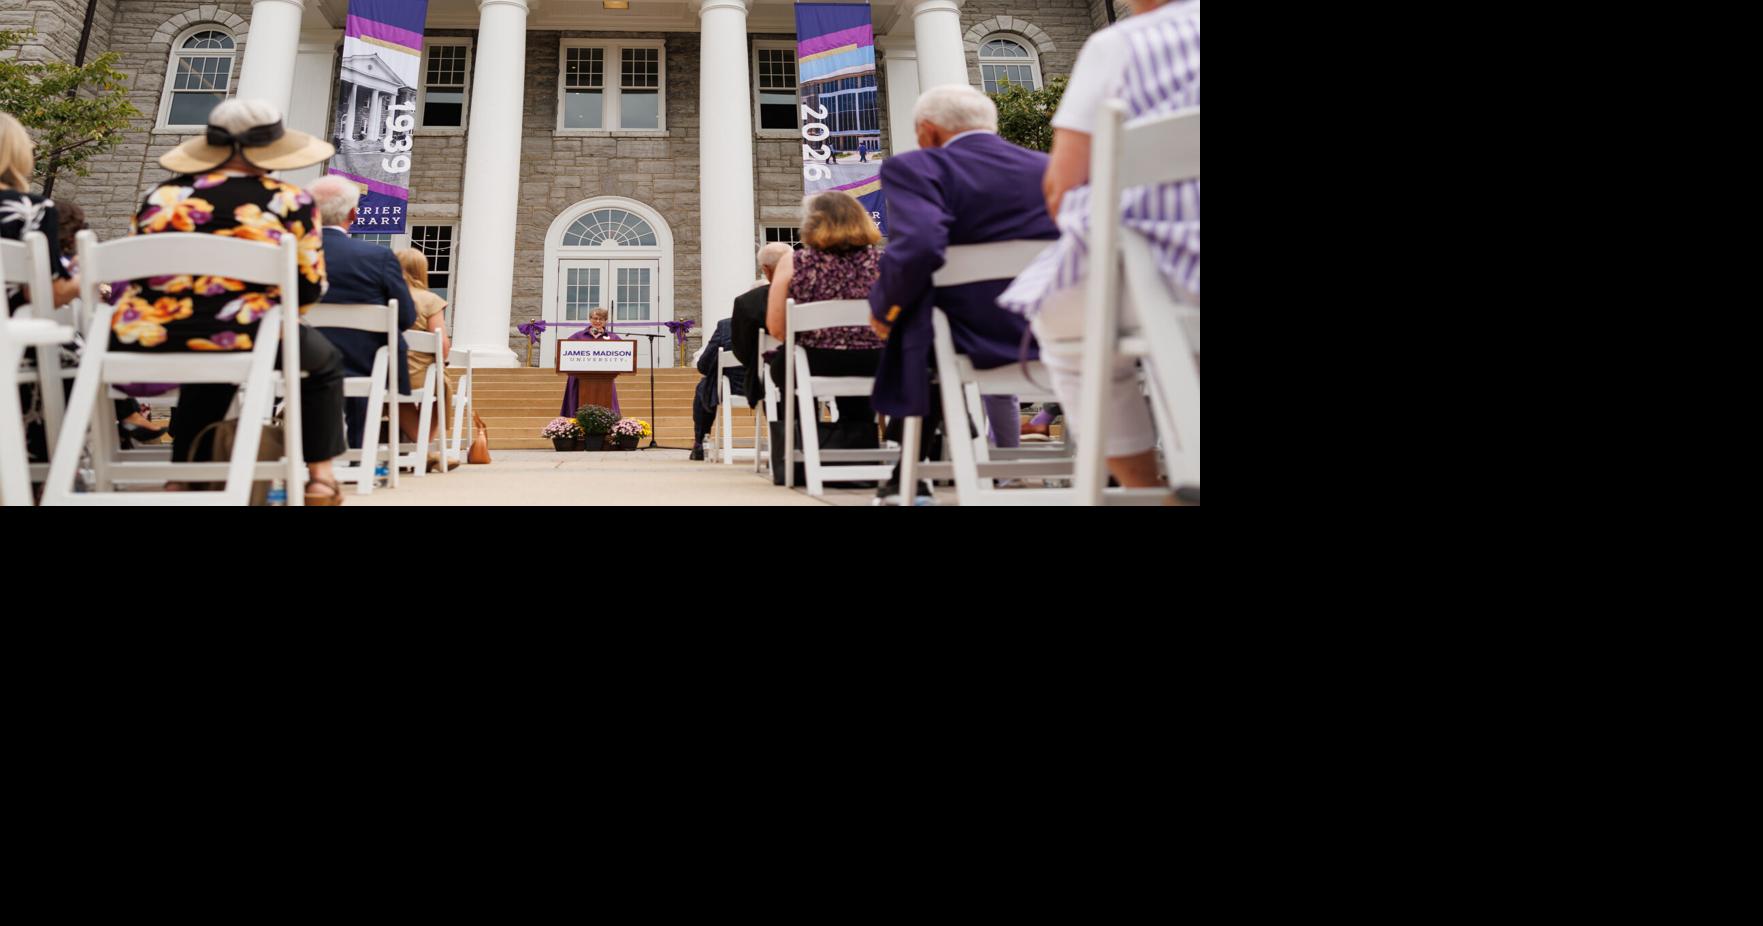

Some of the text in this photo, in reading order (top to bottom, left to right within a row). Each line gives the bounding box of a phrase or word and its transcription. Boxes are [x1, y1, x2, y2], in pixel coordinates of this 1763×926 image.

[381, 101, 415, 174] 1939
[801, 104, 831, 181] 2026
[353, 217, 401, 225] RARY
[355, 206, 402, 215] RRIER
